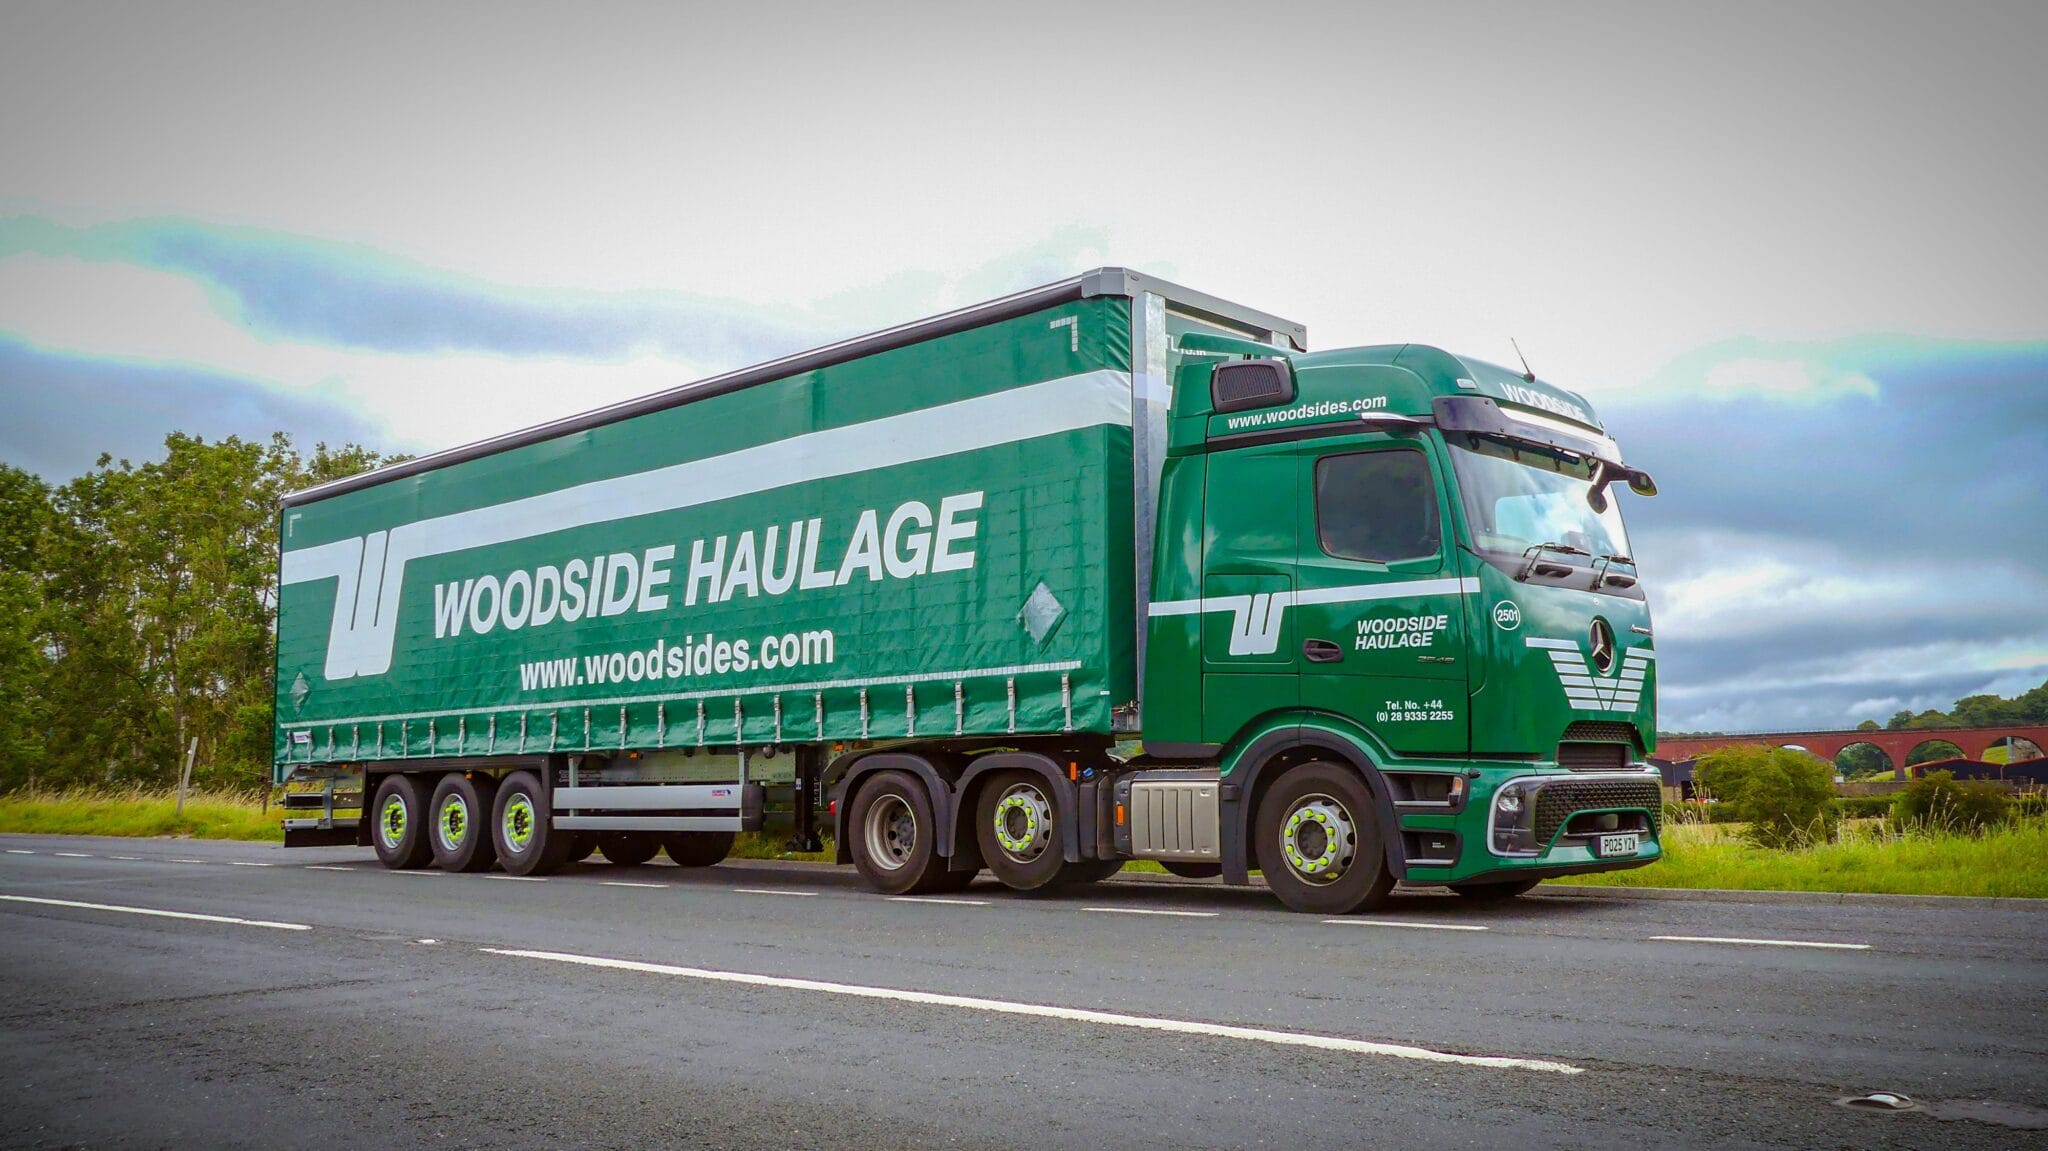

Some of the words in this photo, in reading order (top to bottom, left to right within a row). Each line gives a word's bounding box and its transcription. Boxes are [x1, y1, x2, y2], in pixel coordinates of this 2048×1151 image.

[1499, 382, 1587, 419] WOODSIDE
[1228, 396, 1387, 430] www.woodsides.com
[435, 544, 675, 639] WOODSIDE
[685, 490, 984, 607] HAULAGE
[1357, 615, 1448, 635] WOODSIDE
[1497, 609, 1518, 622] 2501
[1355, 632, 1433, 650] HAULAGE
[520, 629, 834, 691] www.woodsides.com
[1385, 701, 1402, 710] Tel.
[1404, 700, 1420, 710] No.
[1424, 700, 1443, 710] +44
[1376, 711, 1388, 722] (0)
[1391, 711, 1402, 721] 28
[1404, 711, 1427, 721] 9335
[1429, 711, 1454, 721] 2255
